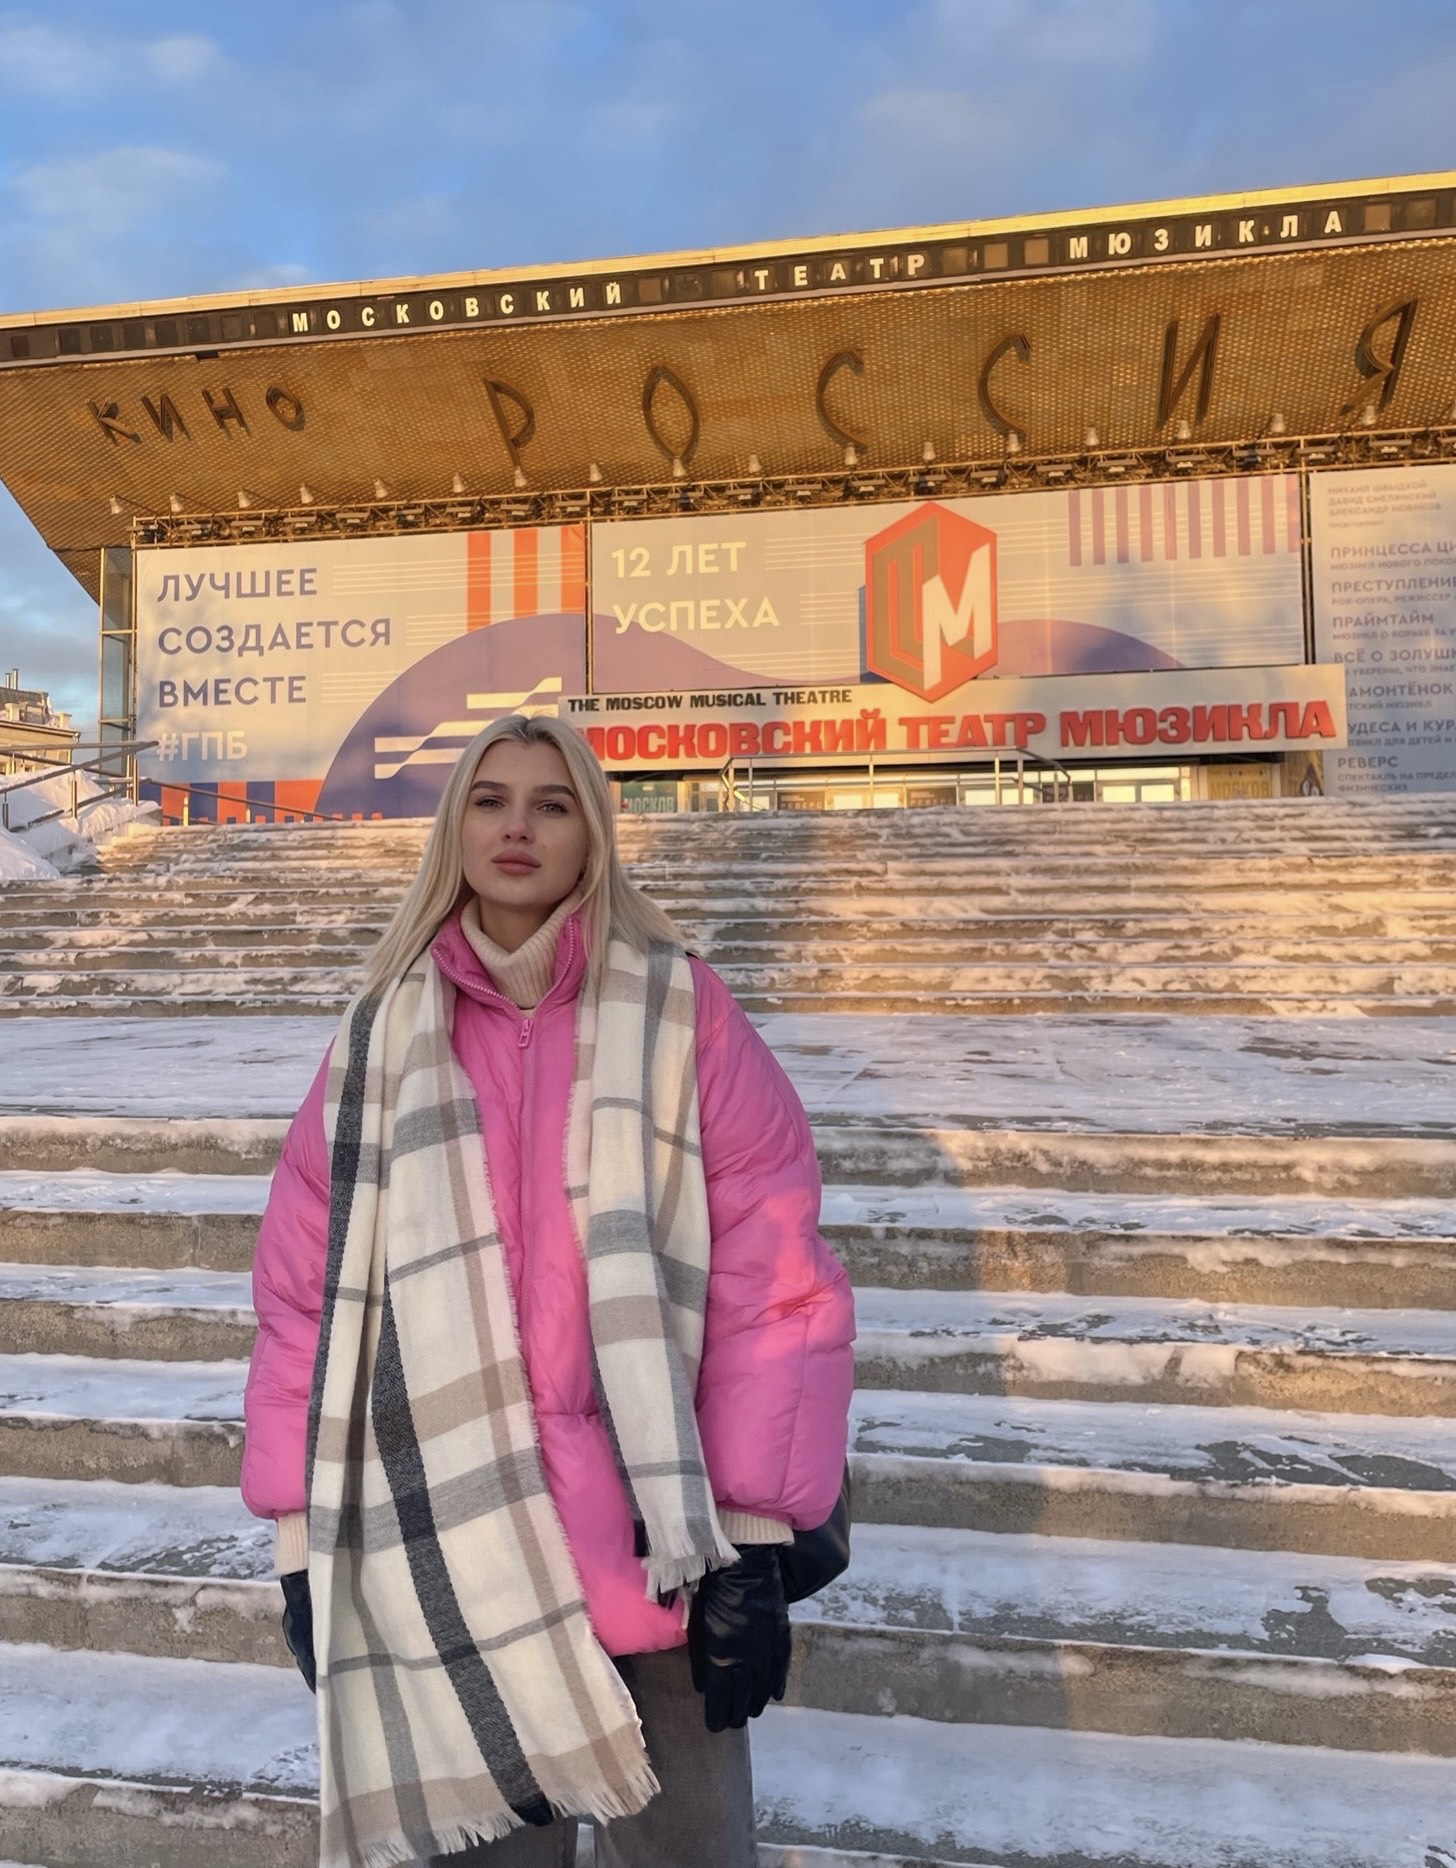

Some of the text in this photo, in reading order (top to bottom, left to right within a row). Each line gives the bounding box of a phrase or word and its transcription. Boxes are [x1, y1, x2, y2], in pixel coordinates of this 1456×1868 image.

[292, 210, 1343, 333] МОСКОВСКИЙ ТЕАТР МЮЗИКЛА
[483, 297, 1420, 468] РОССИЯ
[86, 384, 306, 448] КИНО
[611, 541, 747, 578] 12 ЛЕТ
[1331, 543, 1432, 558] ПРИНЦЕССА
[157, 567, 318, 602] ЛУЧШЕЕ
[612, 596, 780, 634] УСПЕХА
[1333, 610, 1434, 627] ПРАЙМТАЙМ
[157, 618, 392, 657] СОЗДАЕТСЯ
[1334, 647, 1365, 664] ВСЁ
[1371, 650, 1383, 662] О
[158, 675, 307, 708] ВМЕСТЕ
[568, 689, 852, 712] THE MOSCOW MUSICAL THEATRE
[1348, 681, 1454, 697] АМОНТЁНОК
[899, 711, 1046, 750] ТЕАТР
[1060, 700, 1337, 748] МЮЗИКЛА
[1348, 719, 1456, 735] УДЕСА И КУР
[156, 730, 248, 762] #ГПБ
[1337, 756, 1399, 768] РЕВЕРС
